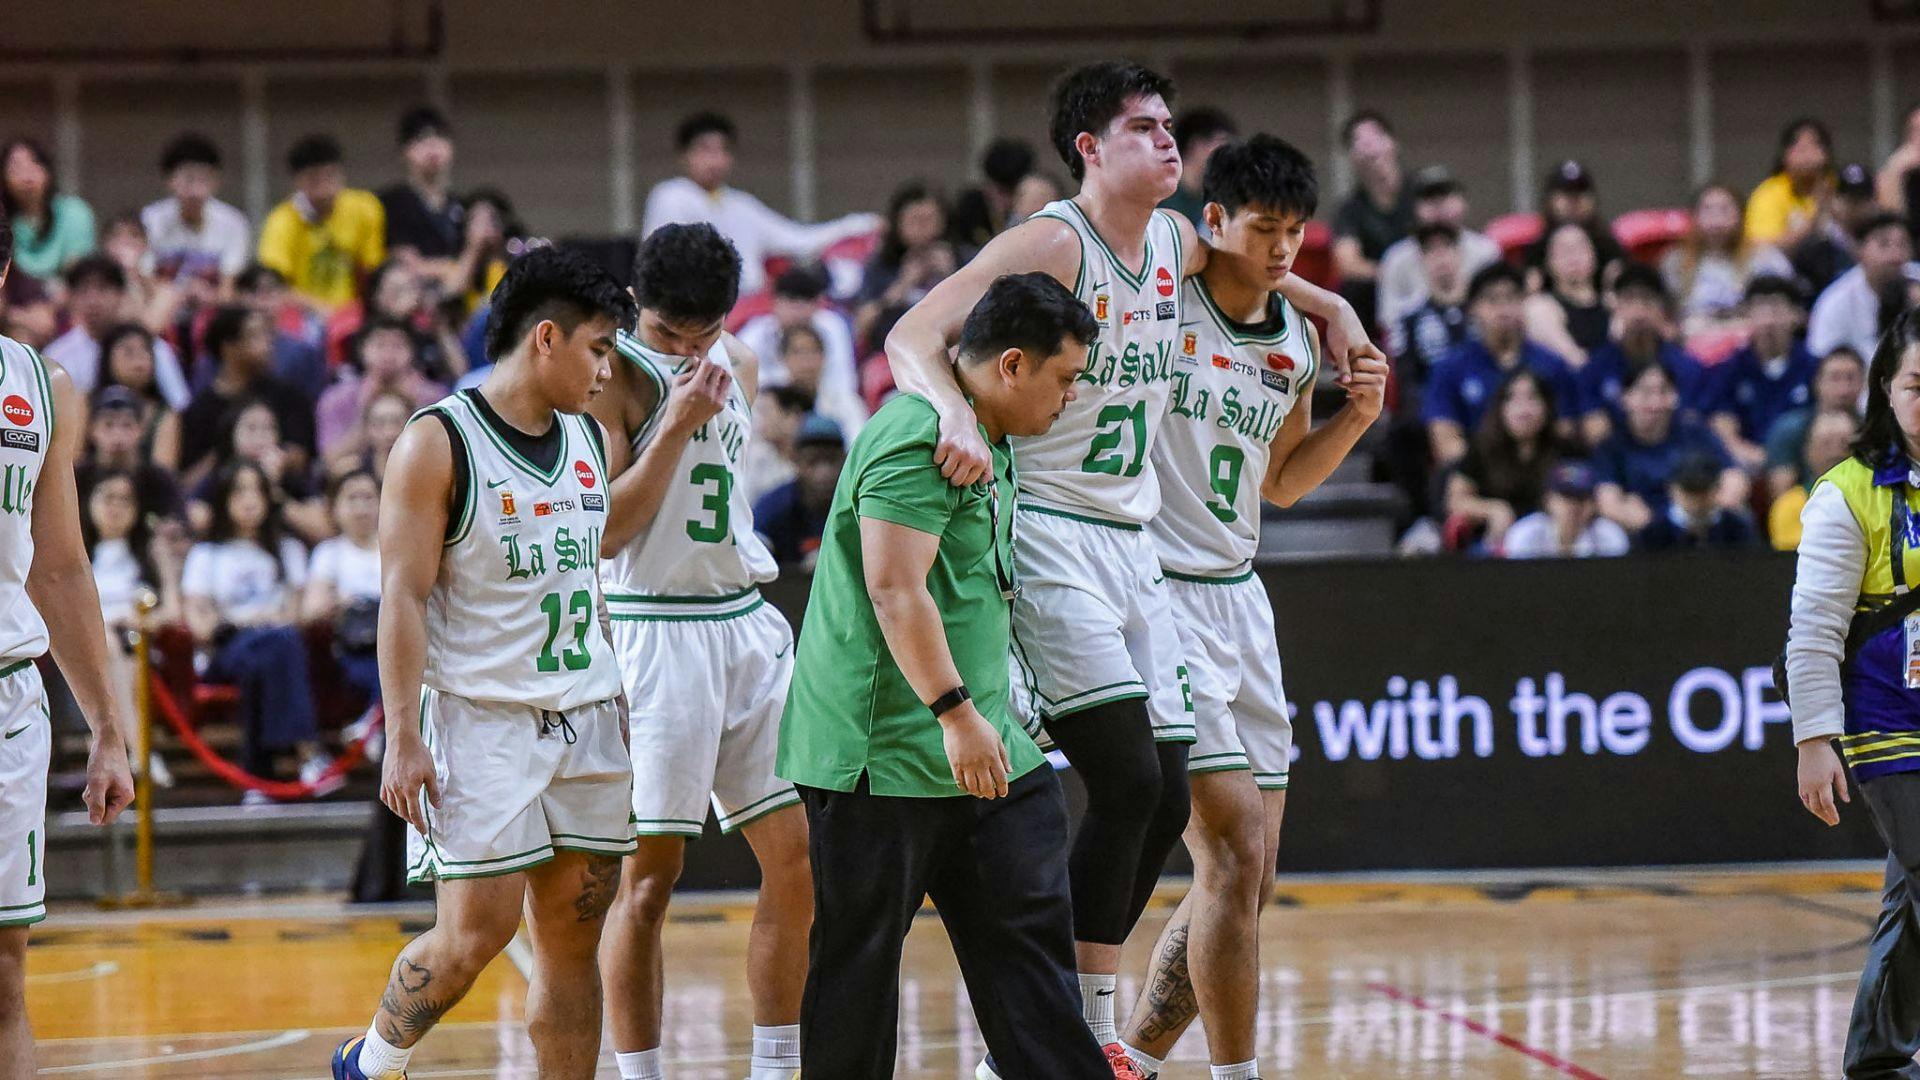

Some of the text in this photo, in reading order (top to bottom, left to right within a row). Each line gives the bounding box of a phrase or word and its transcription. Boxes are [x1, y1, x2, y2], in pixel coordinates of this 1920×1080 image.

[1119, 339, 1173, 388] Sall
[1230, 360, 1257, 377] ICTSI
[4, 404, 32, 417] Gazz
[1170, 370, 1211, 421] La
[8, 432, 34, 444] CWC
[1081, 399, 1148, 477] 21
[1, 463, 32, 516] lle
[550, 500, 576, 513] ICTSI
[686, 462, 737, 546] 3
[1206, 444, 1245, 523] 9
[500, 526, 600, 581] La Sall
[536, 589, 593, 673] 13
[1312, 673, 1496, 763] with
[1508, 670, 1653, 759] the
[27, 829, 37, 888] 1
